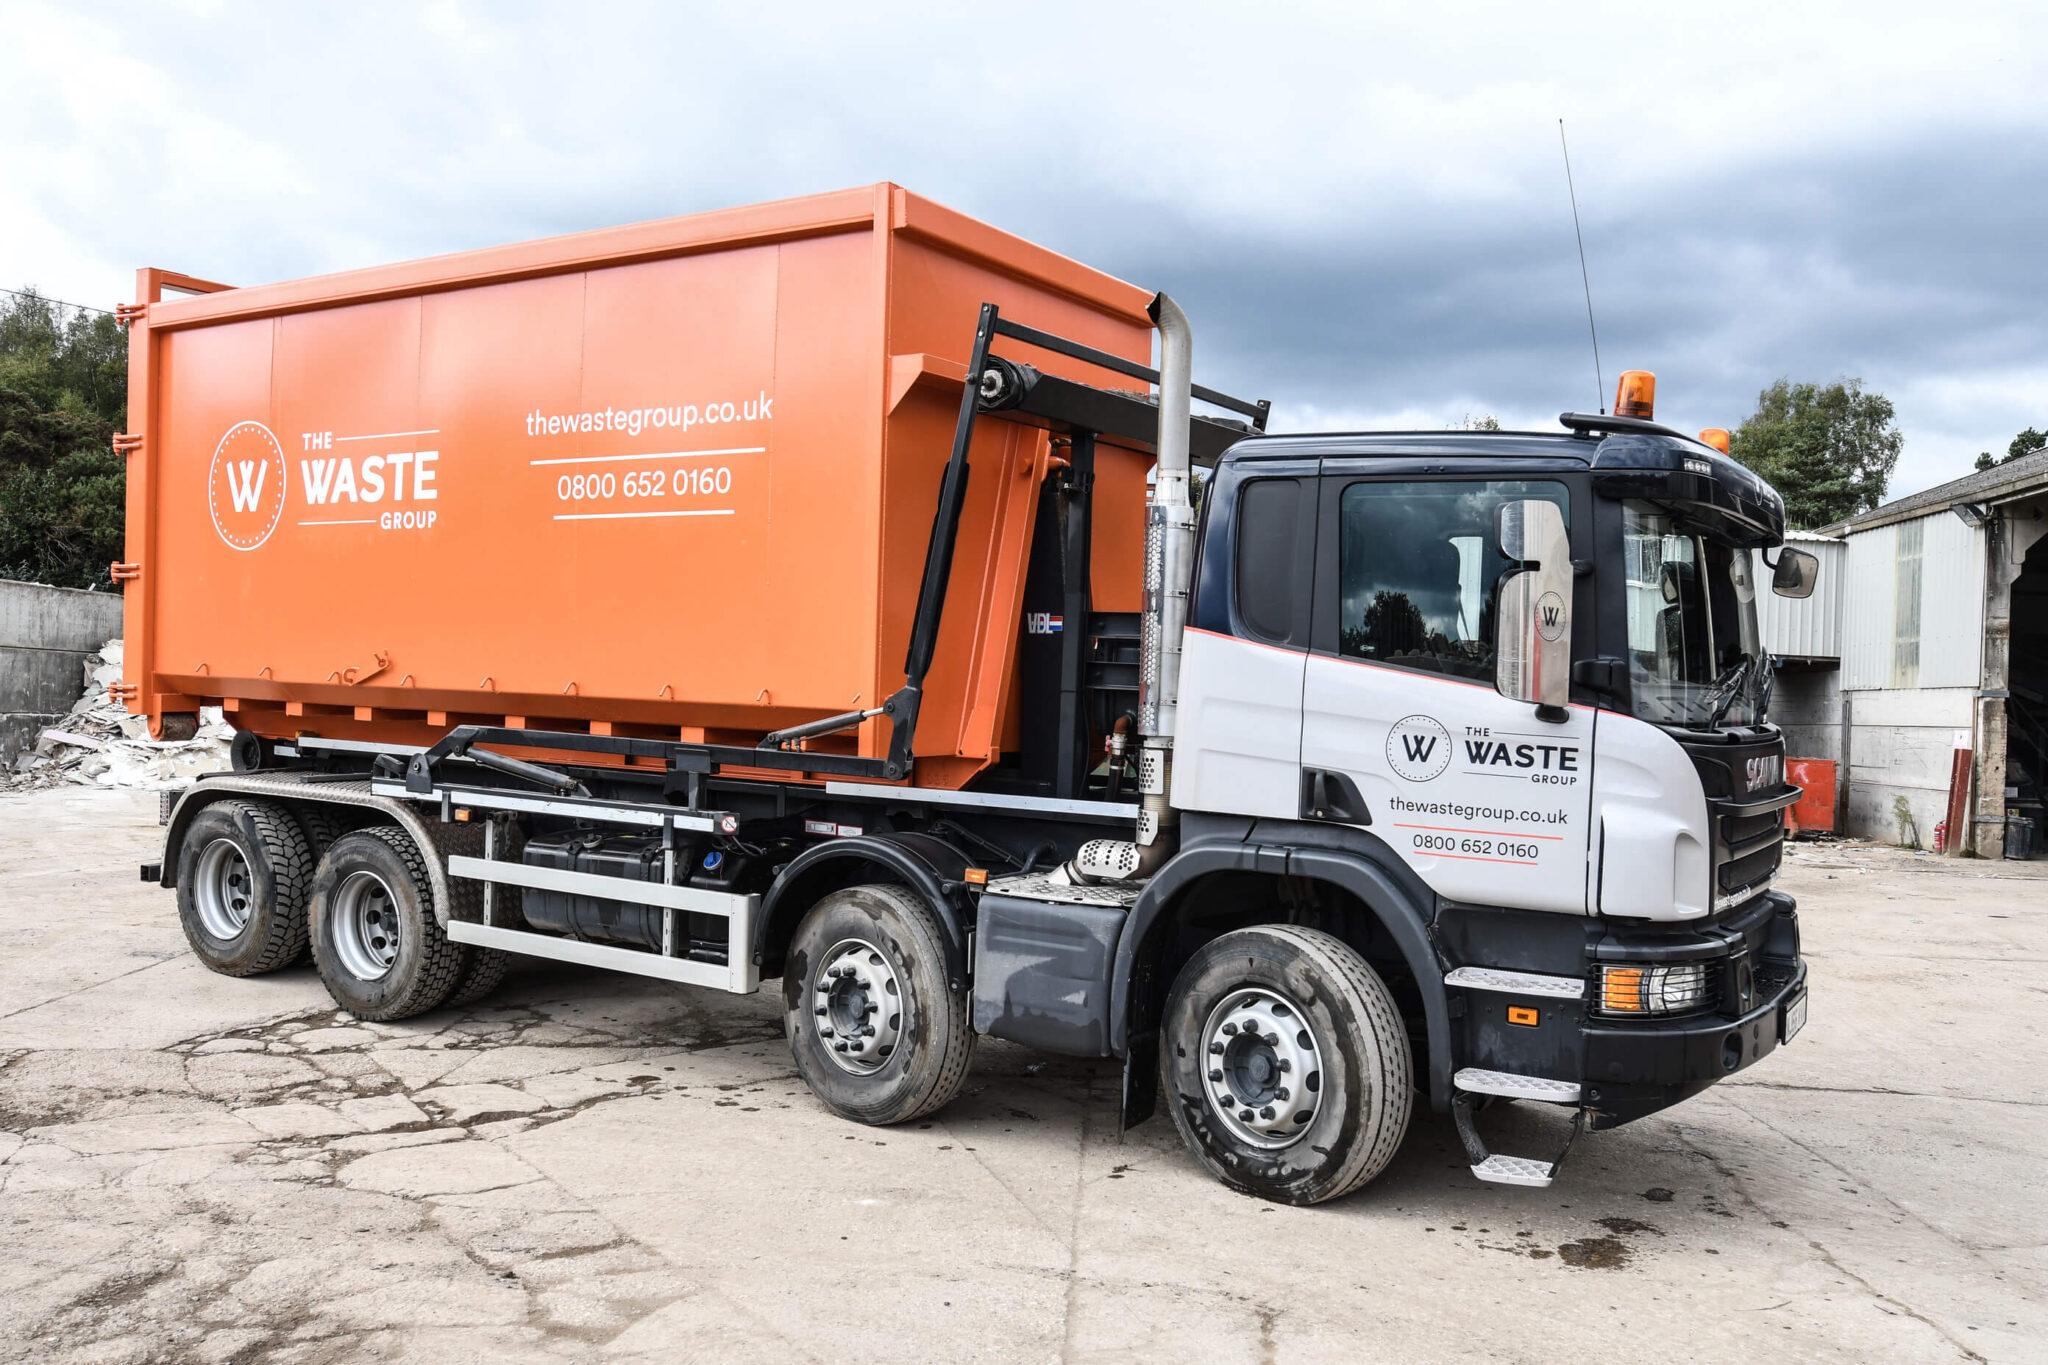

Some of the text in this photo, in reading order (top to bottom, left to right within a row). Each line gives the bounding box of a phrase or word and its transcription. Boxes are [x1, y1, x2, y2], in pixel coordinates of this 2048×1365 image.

[525, 390, 774, 436] thewastegroup.co.uk
[302, 430, 333, 451] THE
[226, 458, 268, 513] W
[300, 450, 439, 505] WASTE
[557, 467, 731, 500] 0800 652 0160
[380, 510, 437, 530] GROUP
[1027, 612, 1053, 634] VDL
[1543, 605, 1559, 627] W
[1465, 726, 1490, 737] THE
[1402, 734, 1437, 763] W
[1465, 740, 1579, 772] WASTE
[1531, 773, 1578, 786] GROUP
[1389, 796, 1568, 825] thewastegroup.co.uk
[1413, 834, 1539, 859] 0800 652 0160
